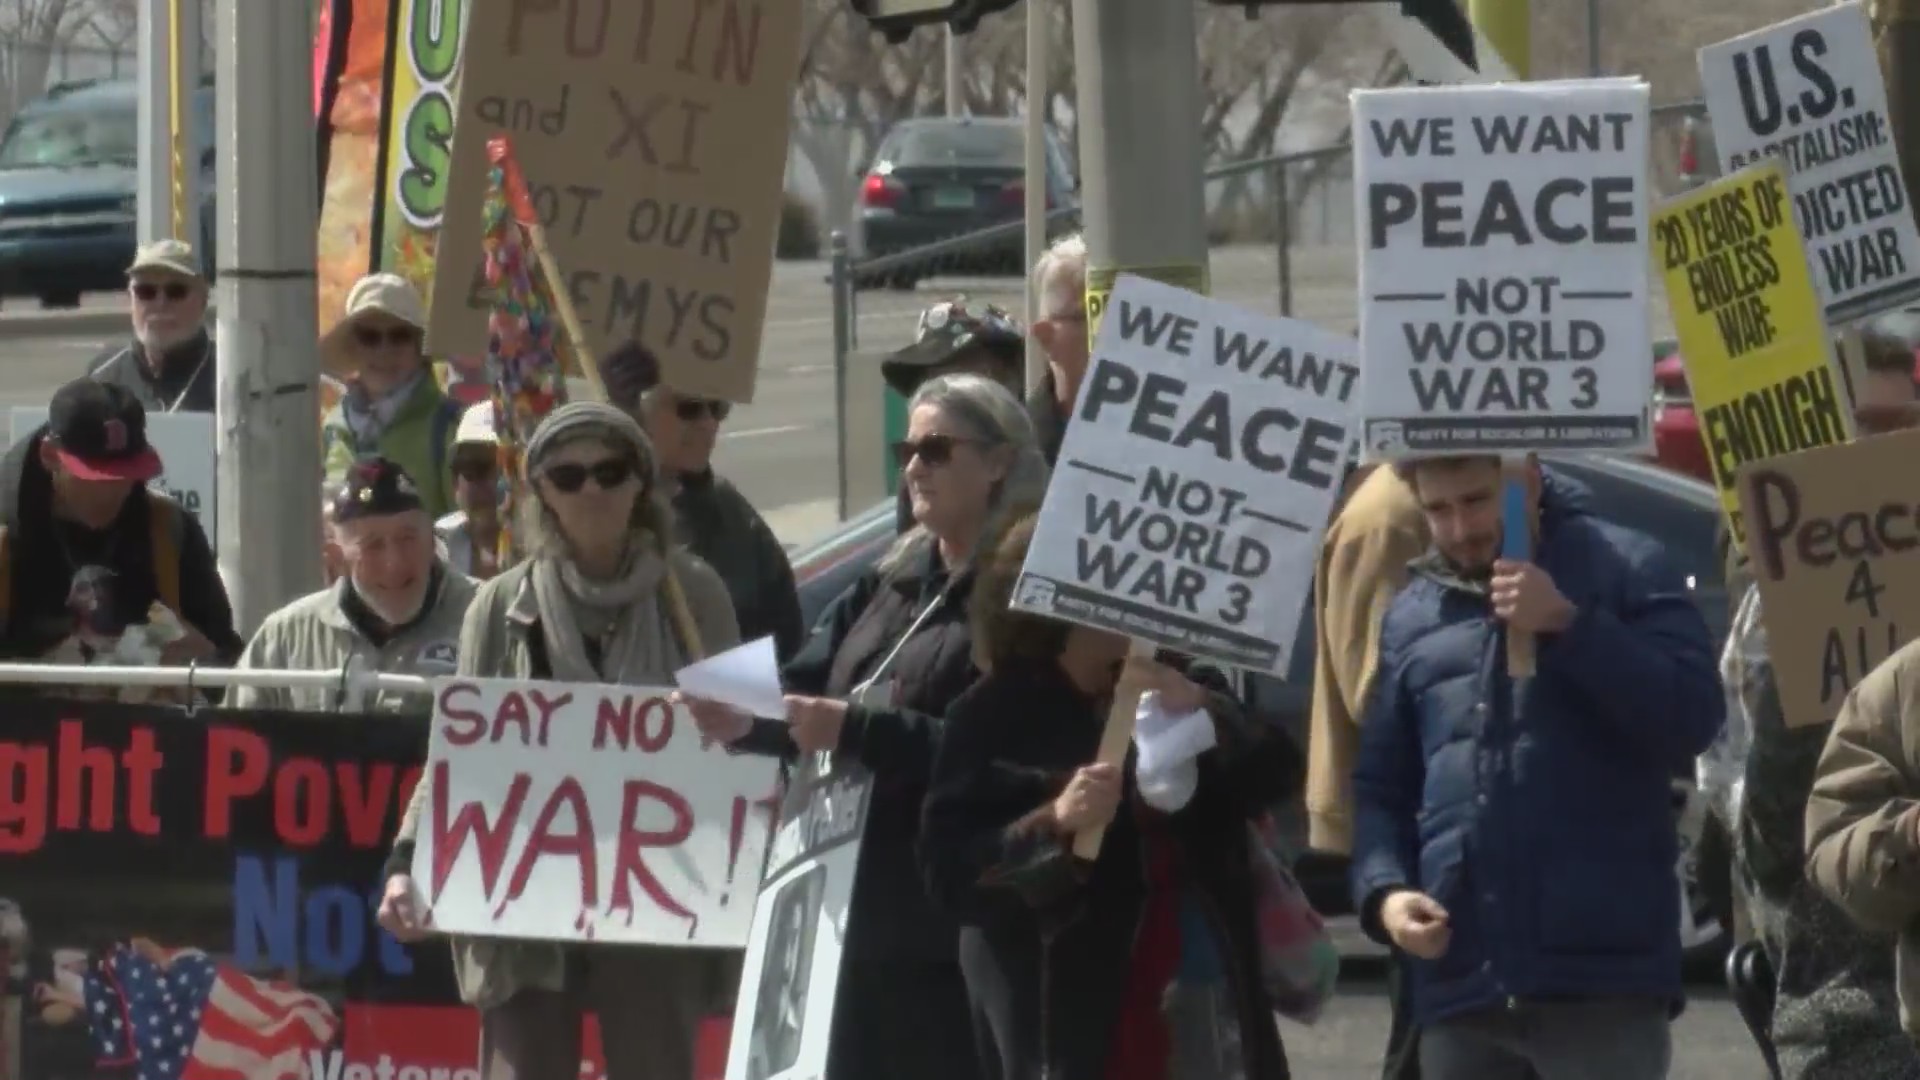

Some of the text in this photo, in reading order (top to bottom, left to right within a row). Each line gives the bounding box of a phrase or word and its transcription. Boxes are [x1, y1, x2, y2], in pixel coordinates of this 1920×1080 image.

[474, 83, 570, 136] and
[1733, 29, 1855, 136] U.S.
[1370, 112, 1633, 158] WE WANT
[526, 182, 741, 264] OT OUR
[1369, 177, 1637, 249] PEACE
[1752, 173, 1783, 230] OF
[1455, 276, 1560, 315] NOT
[1819, 226, 1907, 295] WAR
[465, 262, 735, 361] EEMYS
[1402, 319, 1606, 363] WORLD
[1119, 300, 1199, 357] WE
[1213, 326, 1360, 402] WANT
[1080, 358, 1346, 488] PEACE
[1408, 366, 1599, 412] WAR 3
[1139, 465, 1247, 525] NOT
[1749, 470, 1920, 581] Peac
[1085, 493, 1272, 578] WORLD
[1076, 537, 1207, 613] WAR
[1218, 581, 1254, 626] 3
[1845, 559, 1886, 618] 4
[439, 676, 675, 754] SAY NO
